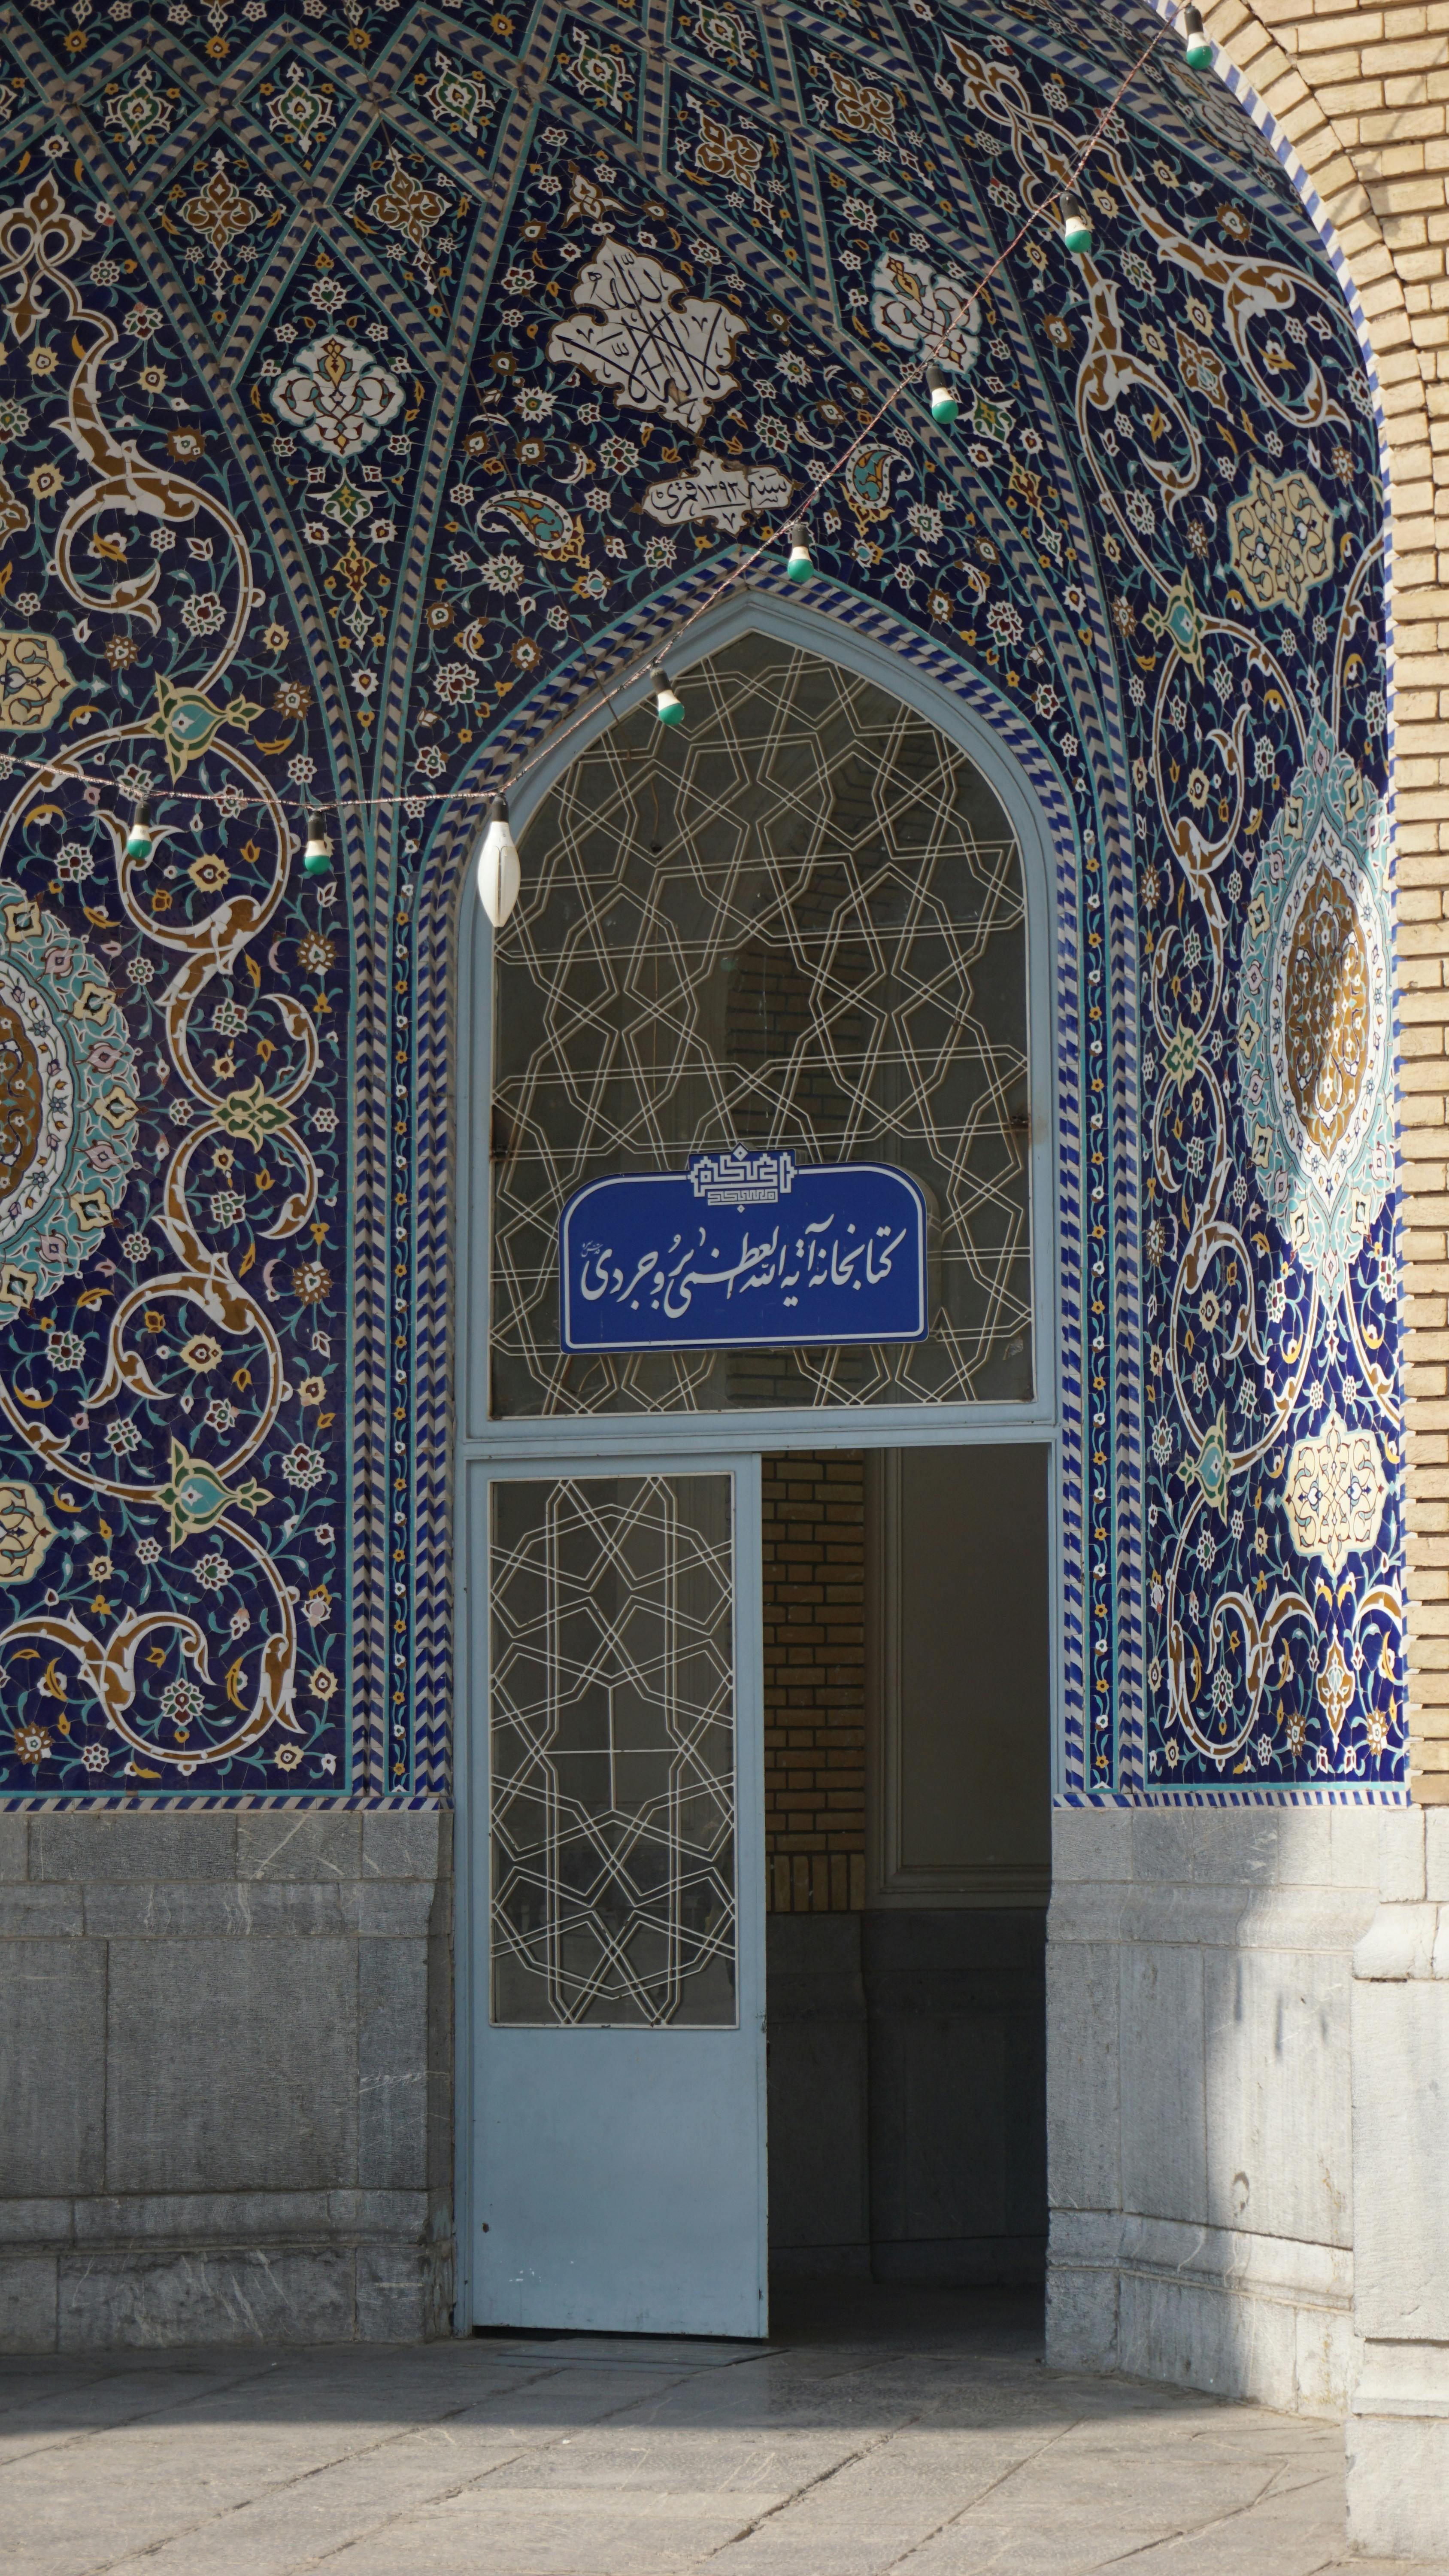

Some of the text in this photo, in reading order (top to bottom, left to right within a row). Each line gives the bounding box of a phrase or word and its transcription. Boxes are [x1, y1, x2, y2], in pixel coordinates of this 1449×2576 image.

[581, 1234, 694, 1311] بروجردی
[739, 1244, 787, 1293] الله
[808, 1223, 906, 1291] کتابخانه
